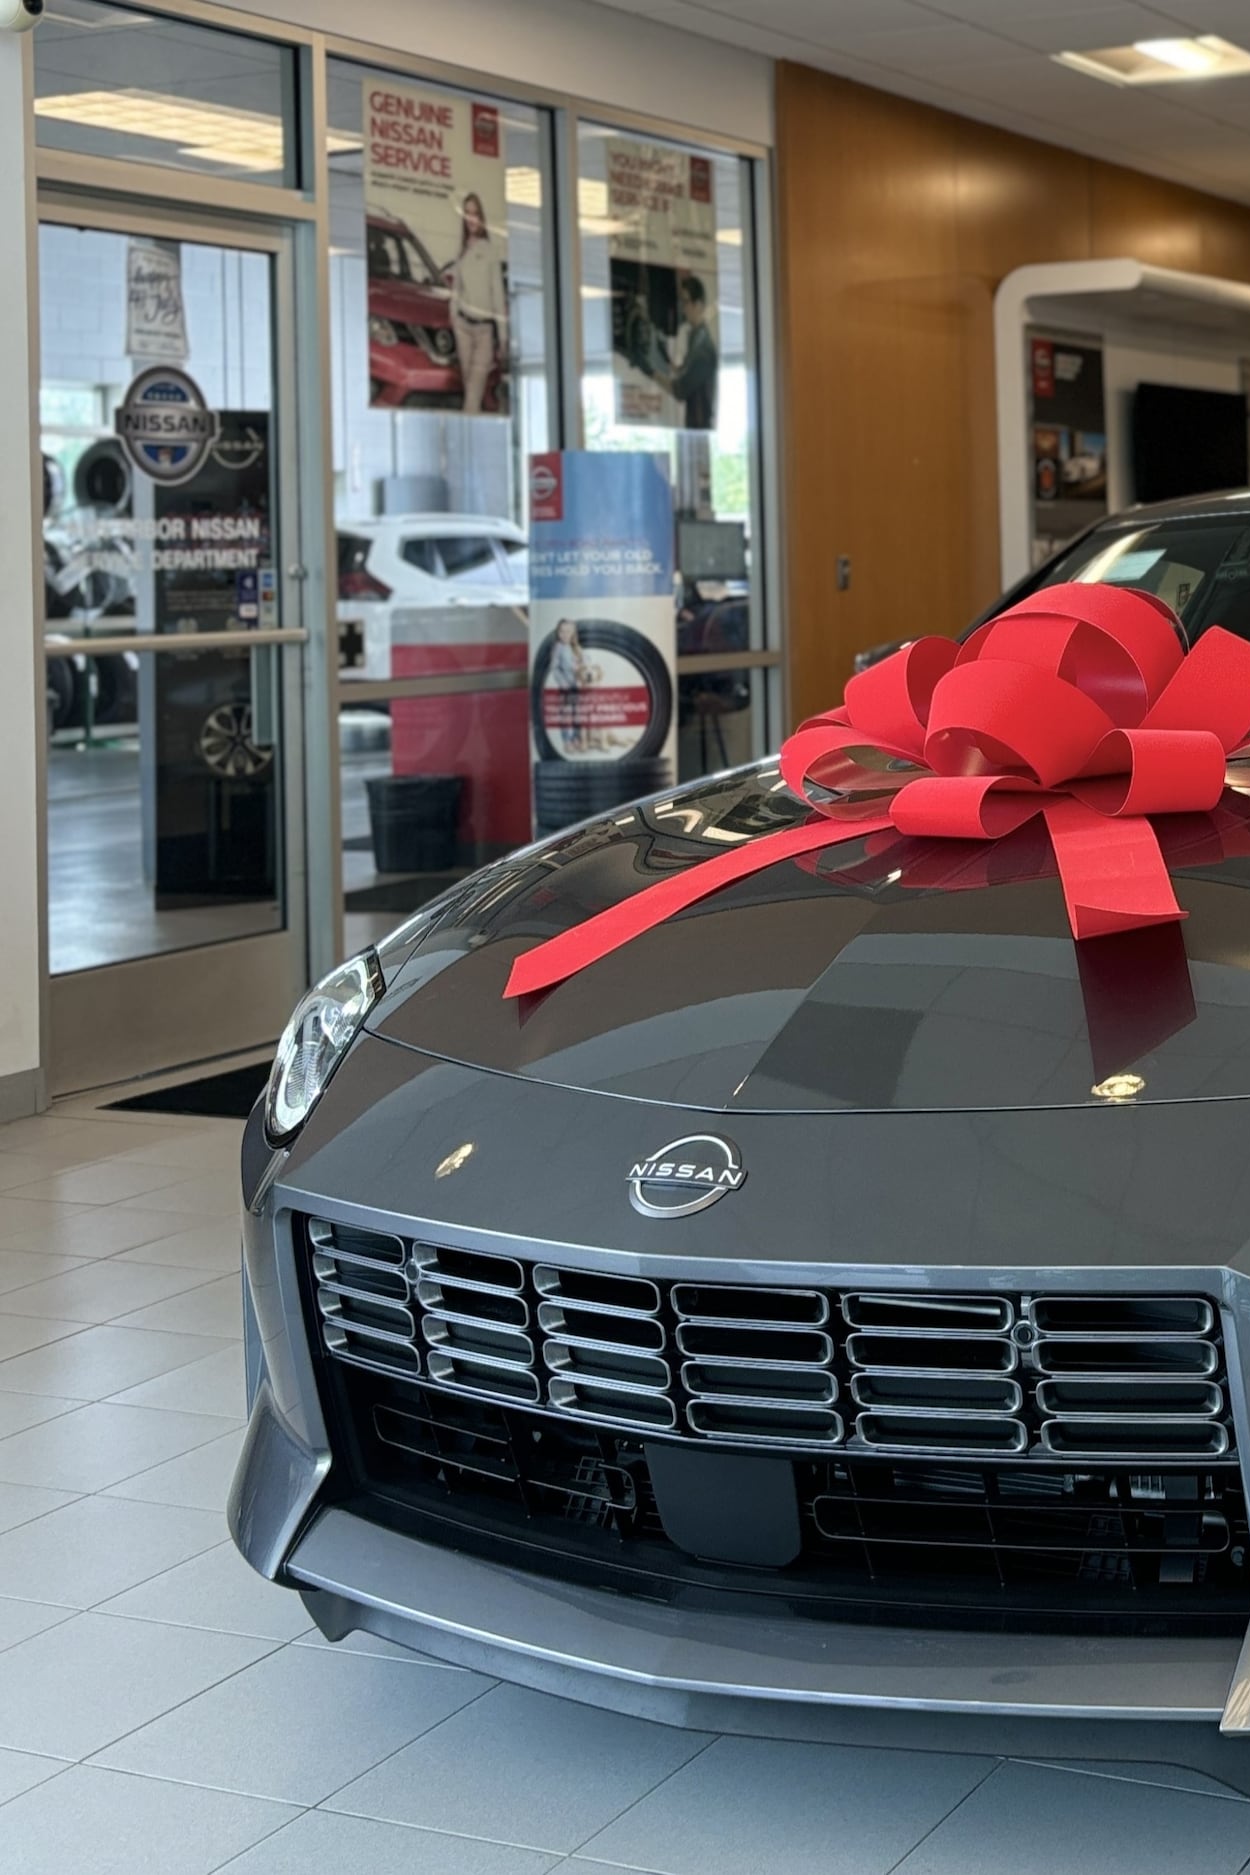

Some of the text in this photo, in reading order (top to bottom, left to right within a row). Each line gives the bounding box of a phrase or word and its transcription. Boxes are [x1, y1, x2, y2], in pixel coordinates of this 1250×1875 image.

[370, 91, 453, 128] GENUINE
[371, 117, 443, 150] NISSAN
[371, 143, 452, 177] SERVICE
[125, 413, 206, 433] NISSAN
[191, 517, 260, 539] NISSAN
[152, 548, 258, 570] DEPARTMENT
[629, 1163, 742, 1186] NISSAN
